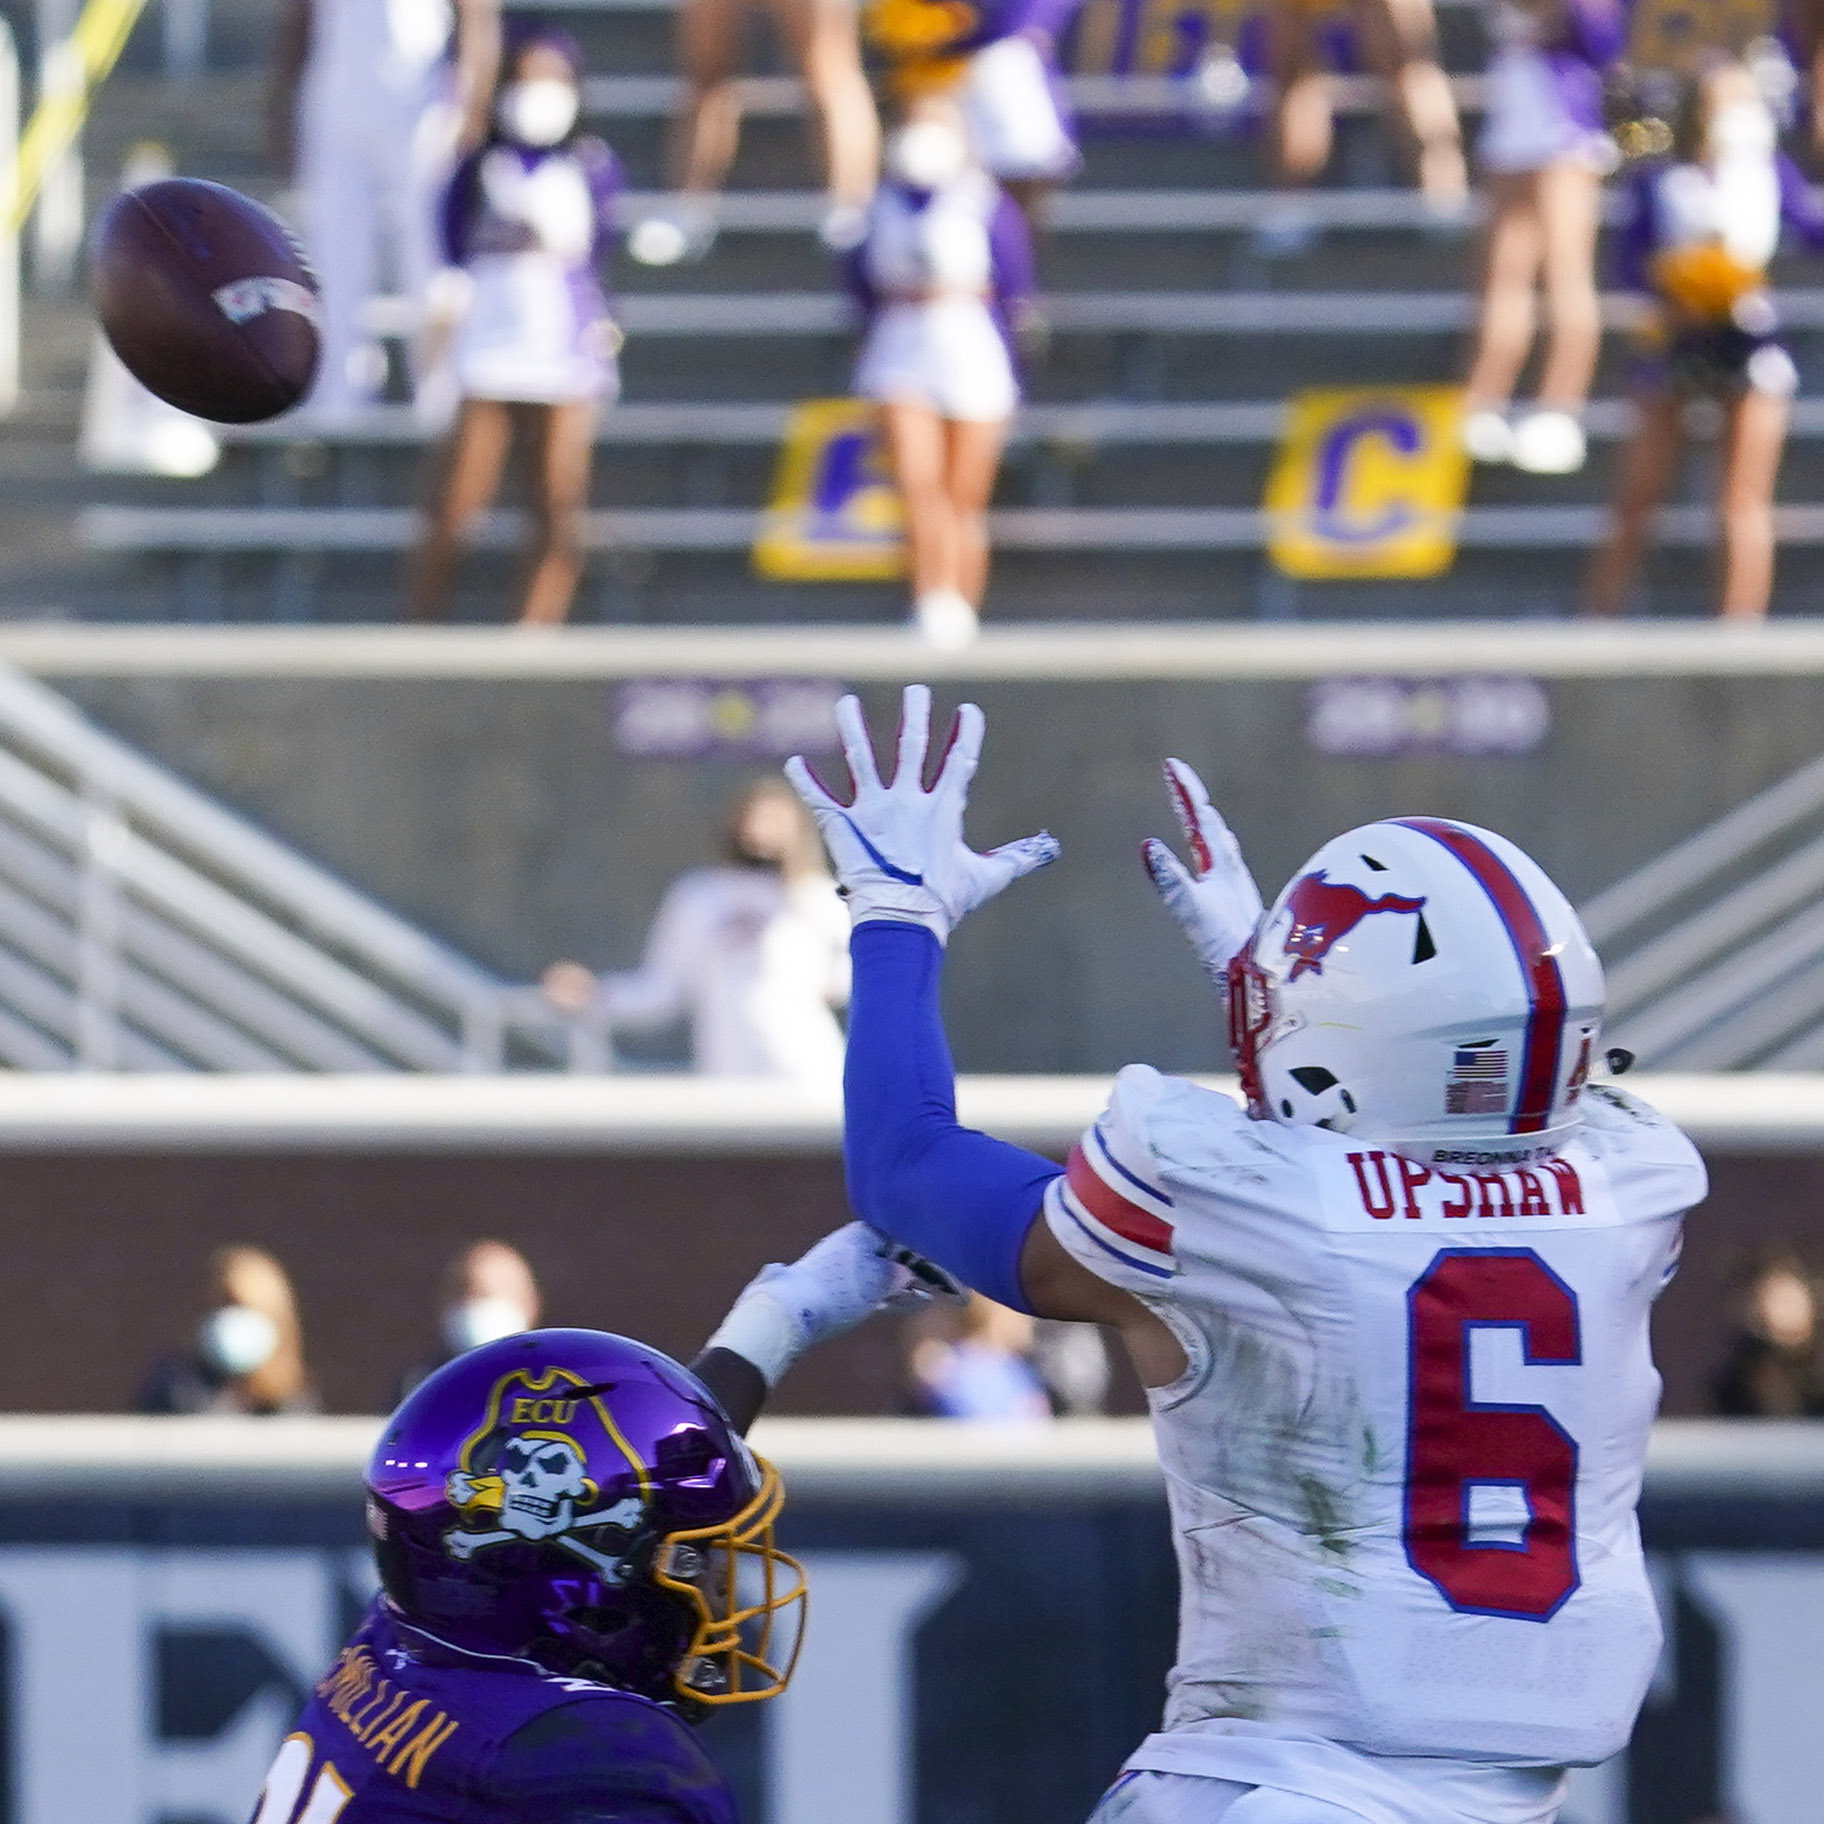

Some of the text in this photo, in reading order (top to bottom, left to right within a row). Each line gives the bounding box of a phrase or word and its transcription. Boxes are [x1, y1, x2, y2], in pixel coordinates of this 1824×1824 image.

[1345, 1151, 1585, 1219] UPSHAW
[510, 1397, 579, 1425] ECU
[1403, 1246, 1583, 1623] 6
